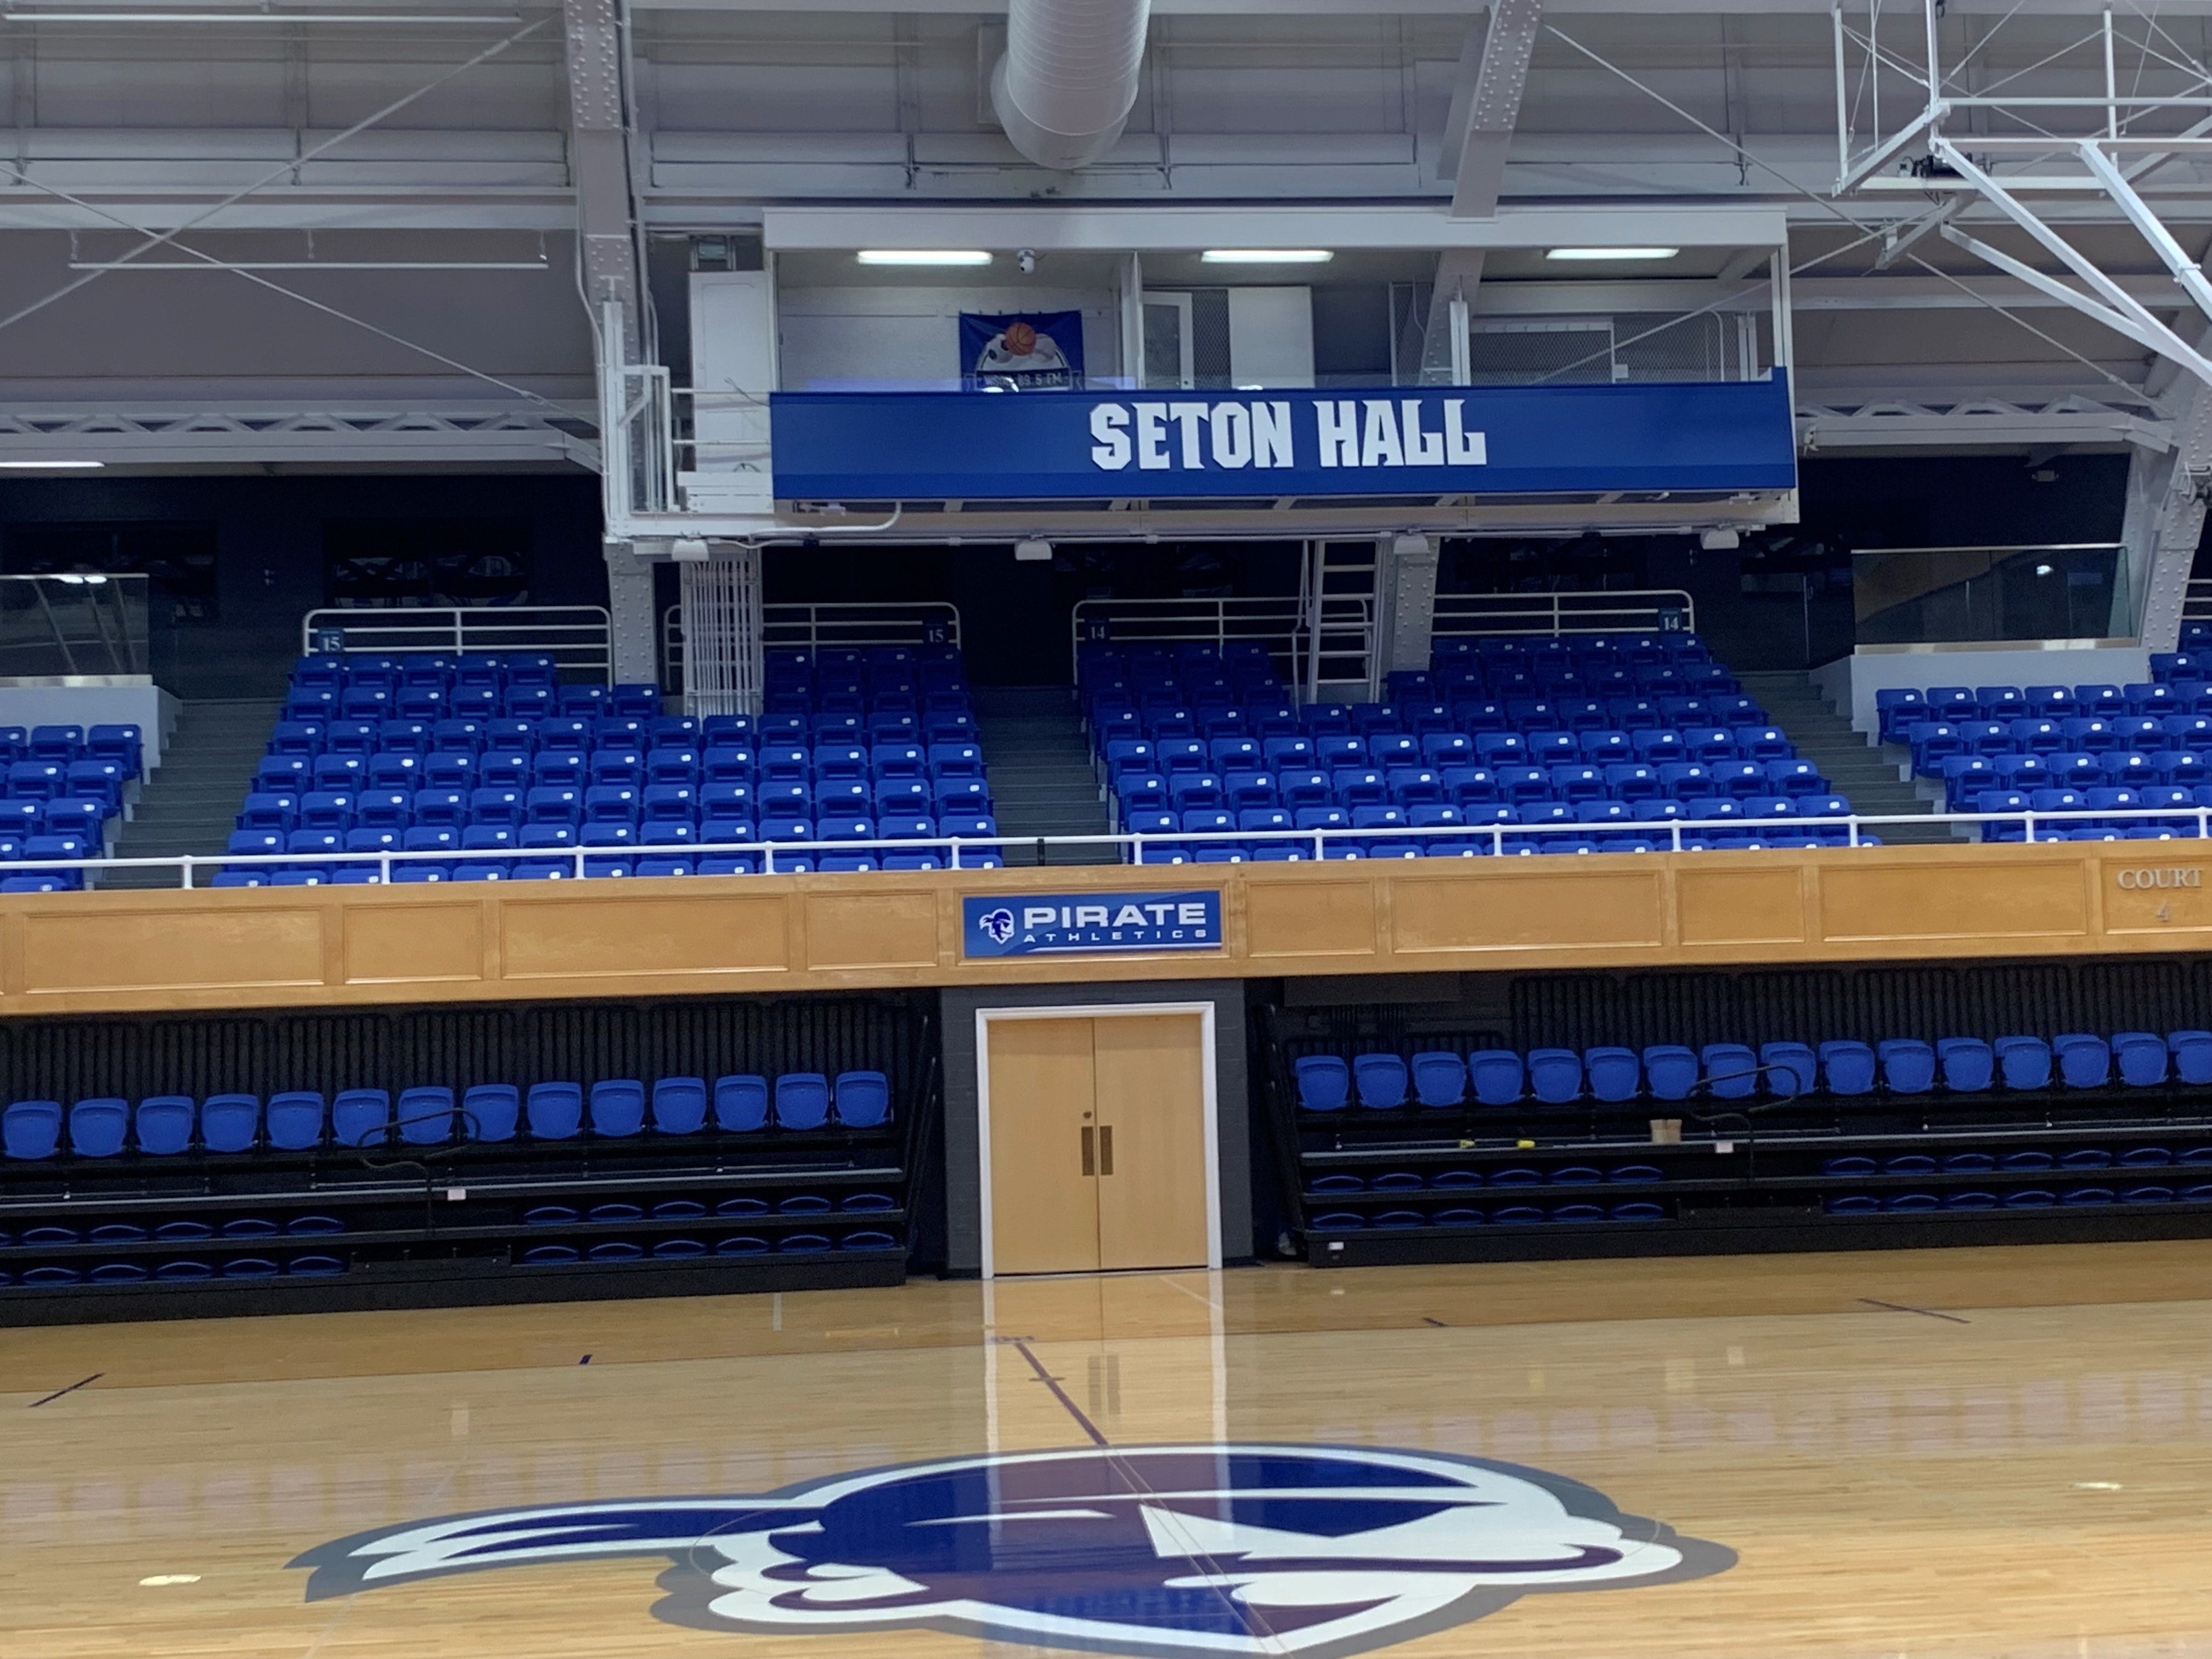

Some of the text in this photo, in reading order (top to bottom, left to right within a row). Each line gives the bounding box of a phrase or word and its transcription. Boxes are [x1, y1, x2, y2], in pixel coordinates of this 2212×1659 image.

[1090, 399, 1487, 470] SETON HALL
[1664, 617, 1679, 630] 14
[929, 629, 944, 643] 15
[1091, 626, 1105, 639] 14
[324, 637, 340, 651] 15
[2117, 868, 2203, 889] COURT
[1024, 903, 1206, 929] PIRATE
[1023, 929, 1206, 943] ATHLETICS
